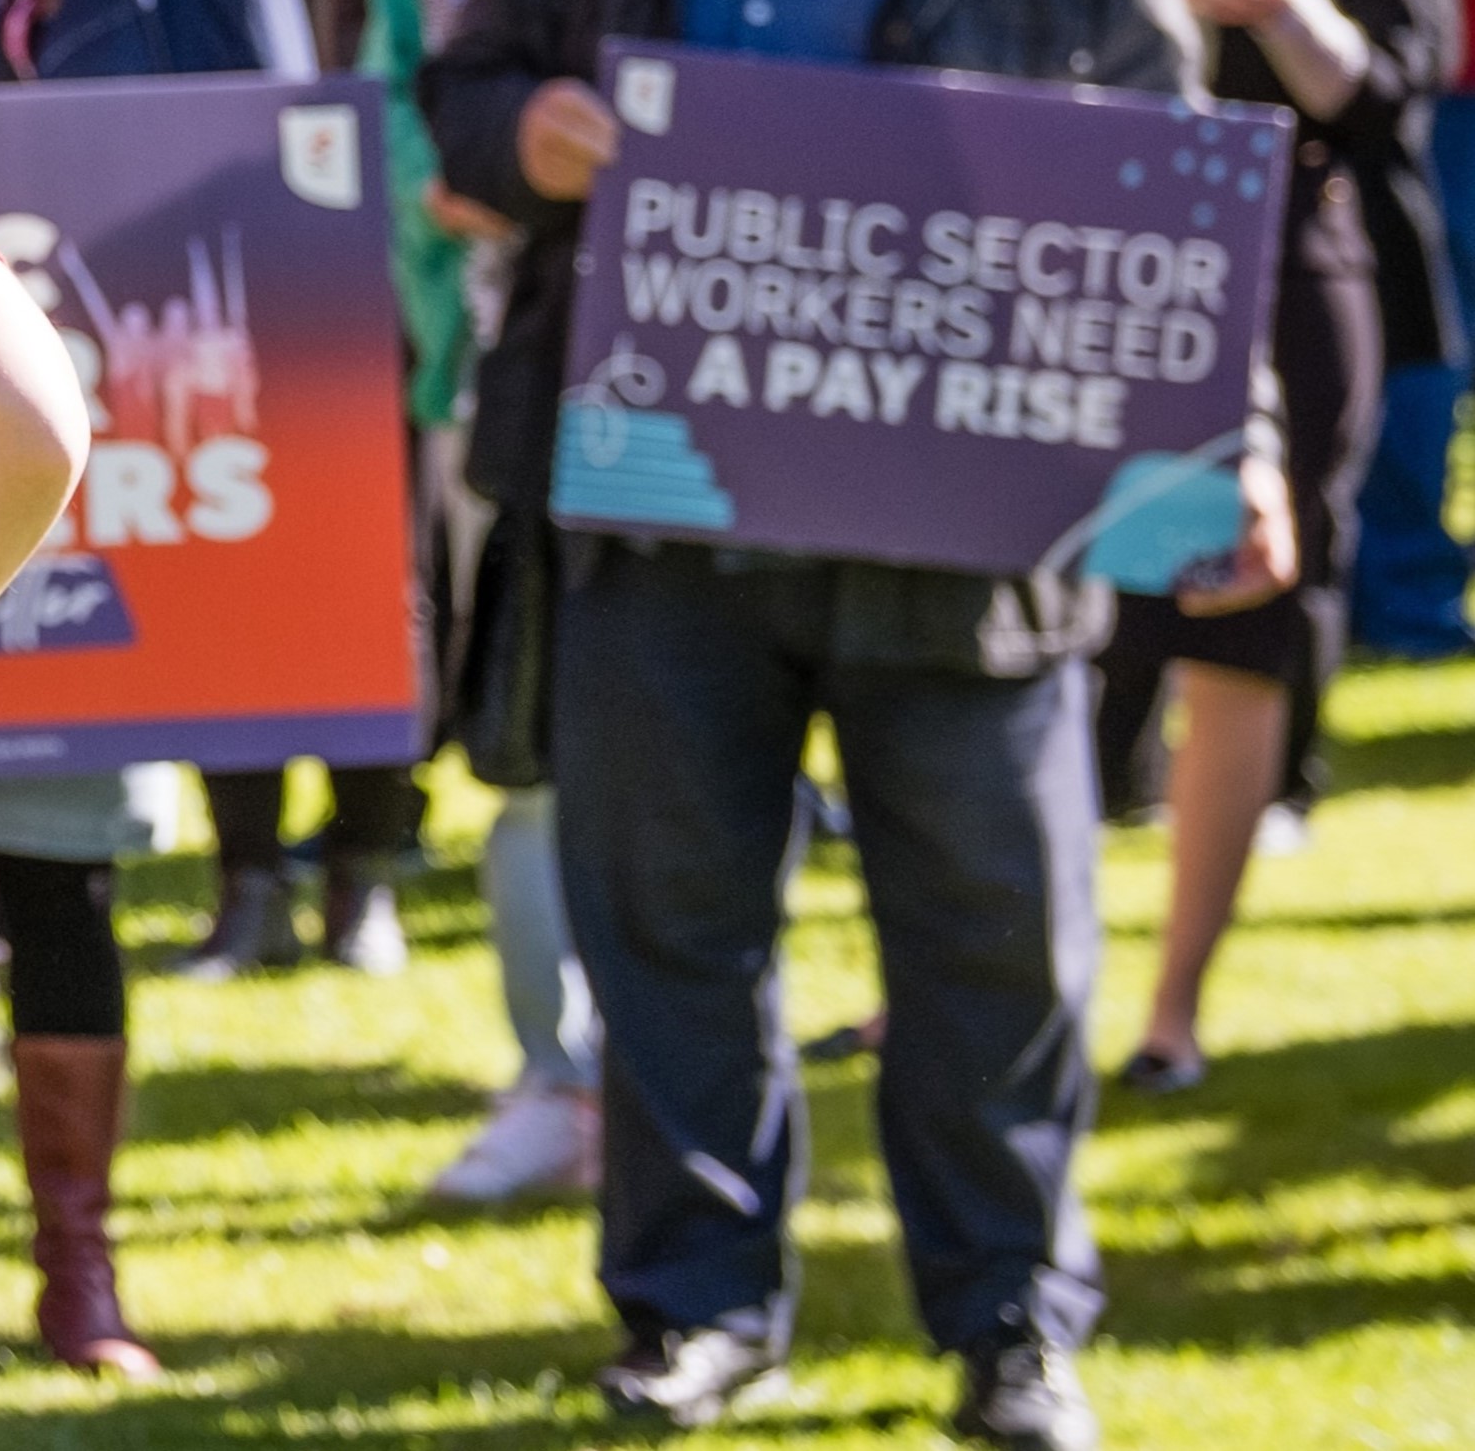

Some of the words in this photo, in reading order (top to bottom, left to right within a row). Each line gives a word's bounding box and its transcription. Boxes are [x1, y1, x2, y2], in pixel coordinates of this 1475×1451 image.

[625, 178, 908, 278] PUBLIC
[918, 209, 1231, 315] SECTOR
[621, 251, 995, 359] WORKERS
[1009, 294, 1219, 383] NEED
[687, 333, 750, 409] A
[762, 340, 926, 426] PAY
[935, 359, 1127, 449] RISE
